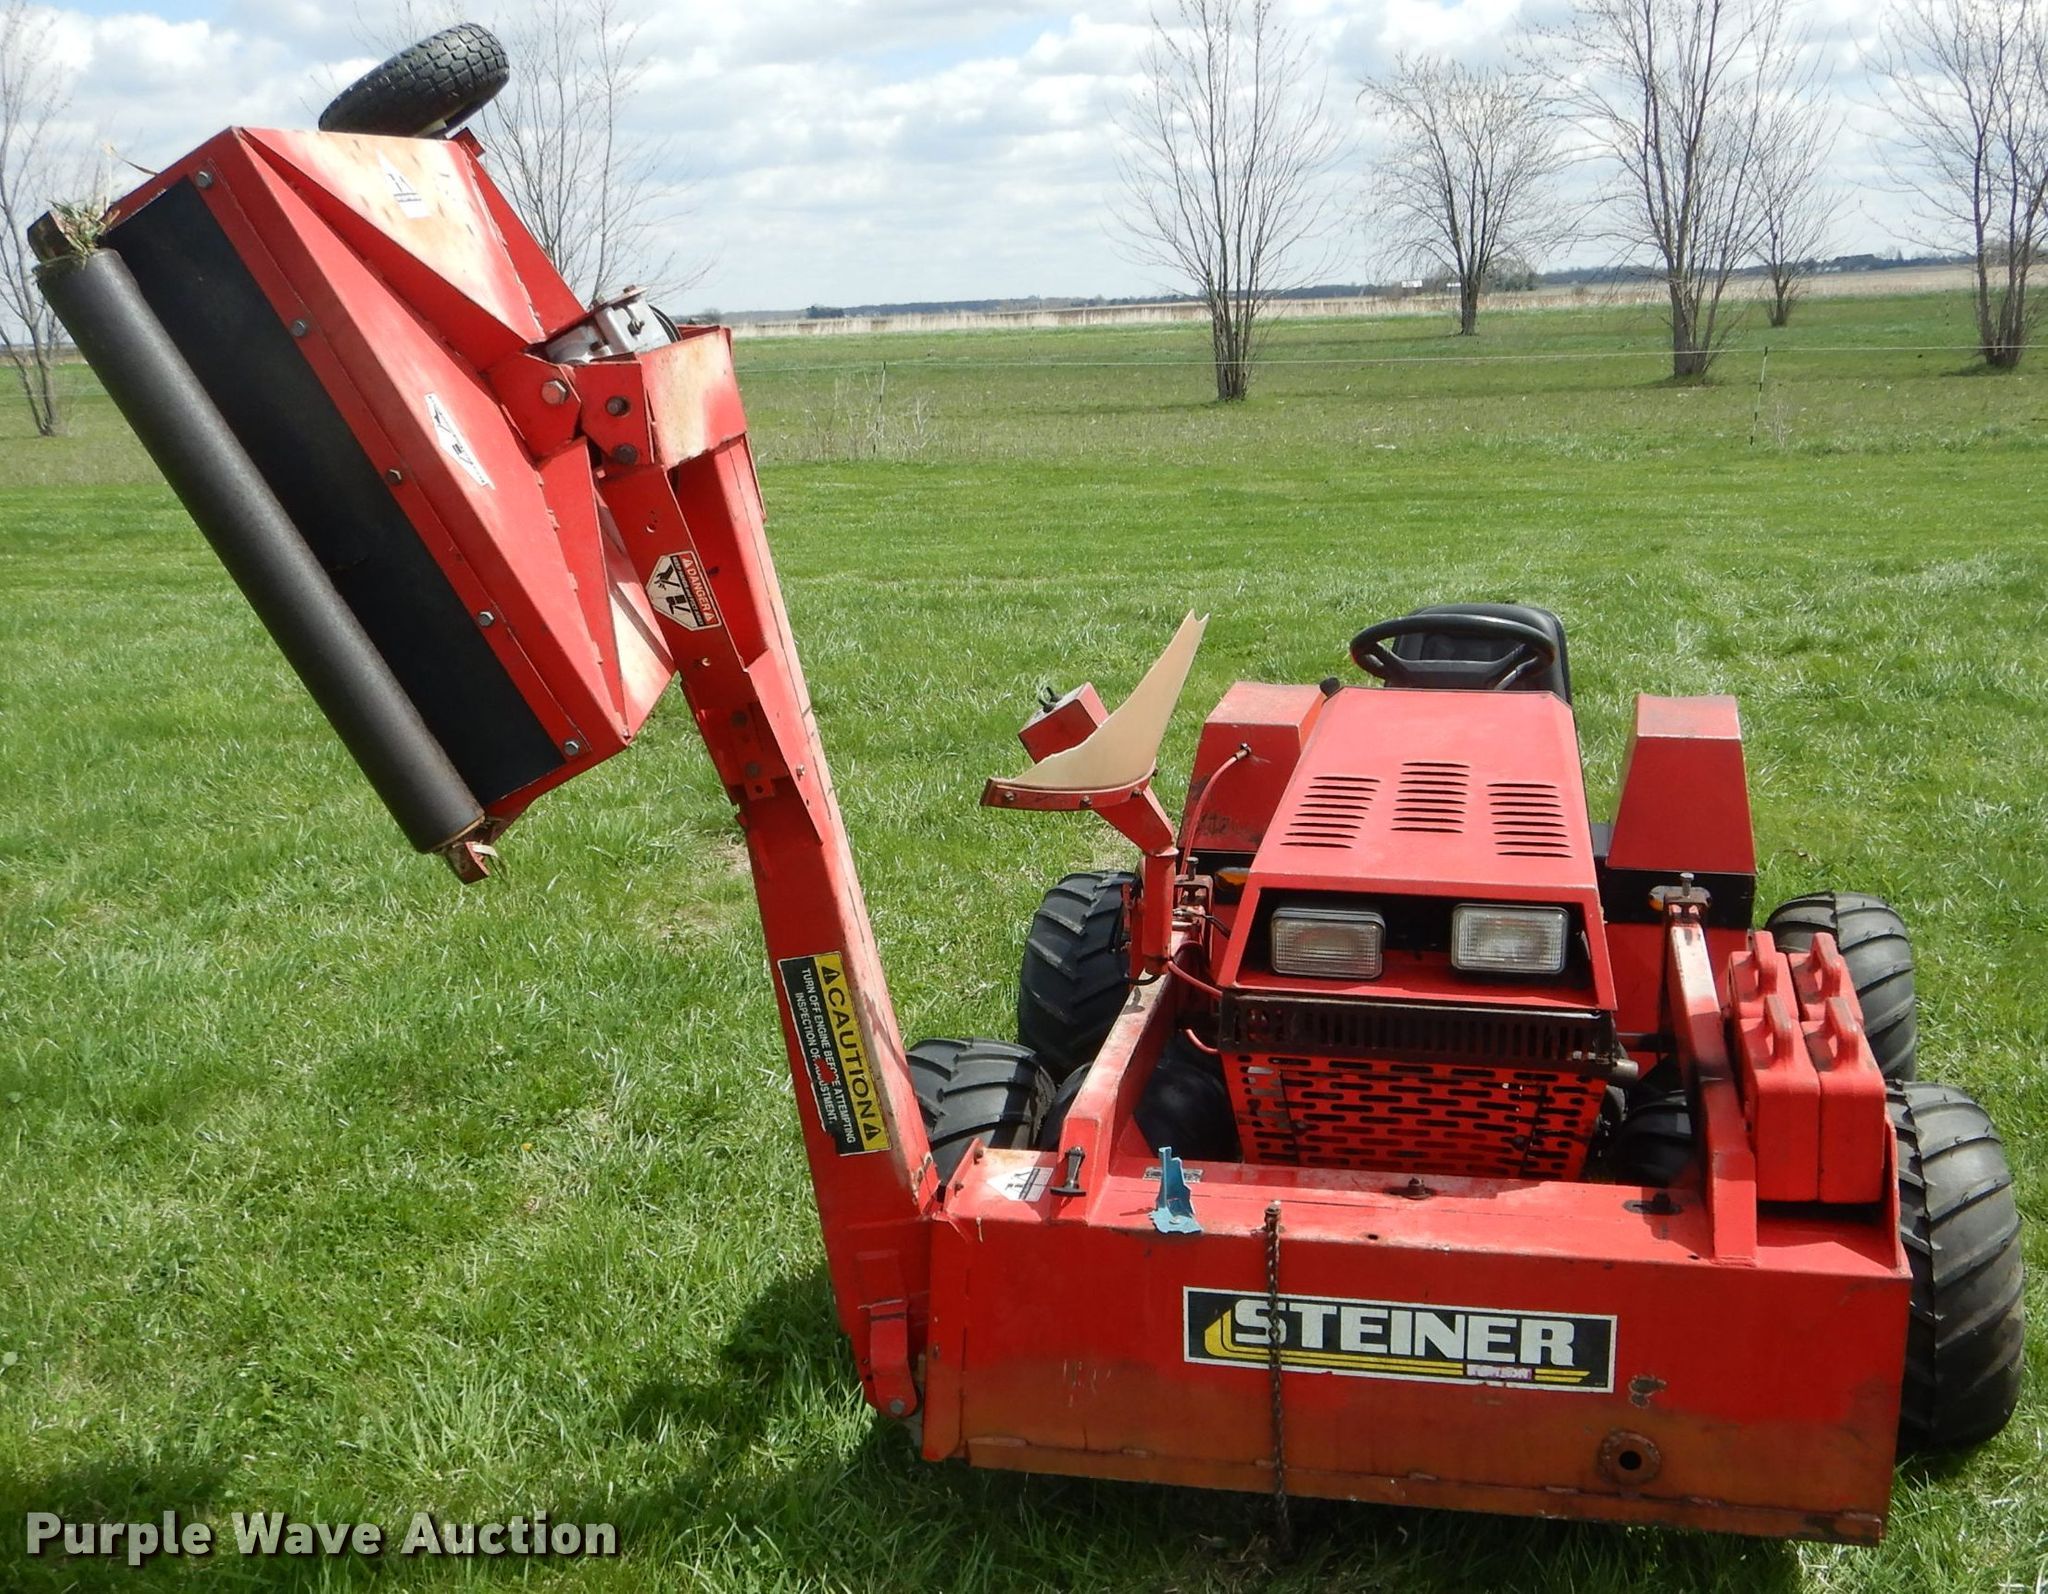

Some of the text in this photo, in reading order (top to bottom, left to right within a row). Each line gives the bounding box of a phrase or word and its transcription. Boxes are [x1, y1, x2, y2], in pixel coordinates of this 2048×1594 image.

[686, 567, 711, 611] DANGER
[801, 967, 816, 993] TURN
[808, 995, 822, 1014] OFF
[795, 992, 817, 1046] INSPECTION
[813, 1015, 831, 1049] ENGINE
[828, 986, 876, 1119] CAUTION
[833, 1086, 856, 1143] ATTEMPTING
[1235, 1299, 1575, 1366] STEINER
